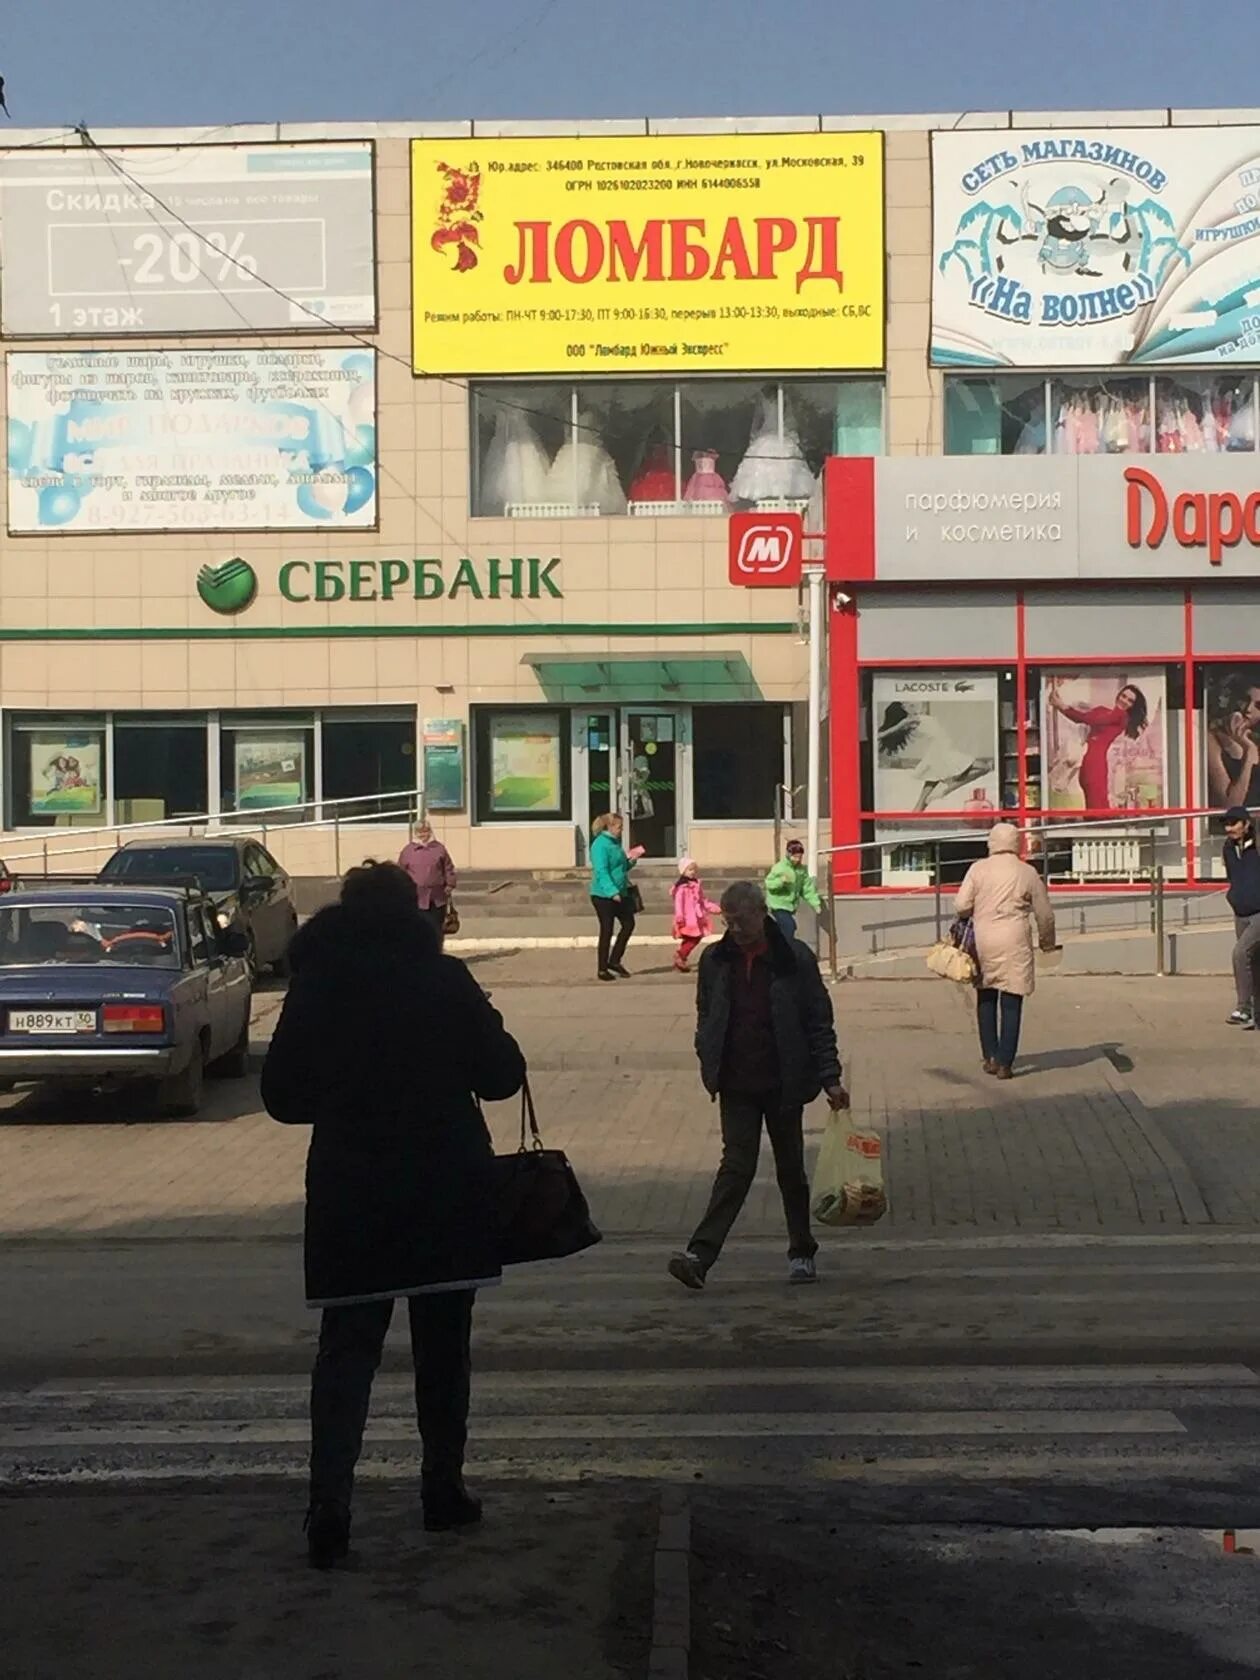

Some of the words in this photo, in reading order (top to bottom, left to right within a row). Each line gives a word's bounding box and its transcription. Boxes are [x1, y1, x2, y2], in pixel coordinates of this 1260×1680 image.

[852, 155, 865, 167] 39
[961, 150, 1018, 192] СЕТЬ
[1020, 139, 1167, 191] МАГАЗИНОВ
[46, 189, 155, 213] Скидка
[118, 231, 258, 284] -20%
[503, 216, 844, 295] ЛОМБАРД
[49, 302, 62, 328] 1
[73, 306, 144, 328] этаж
[904, 489, 1062, 513] парфюмерия
[905, 525, 918, 541] и
[940, 522, 1062, 542] косметика
[278, 557, 565, 603] СБЕРБАНК
[894, 681, 950, 693] LACOSTE
